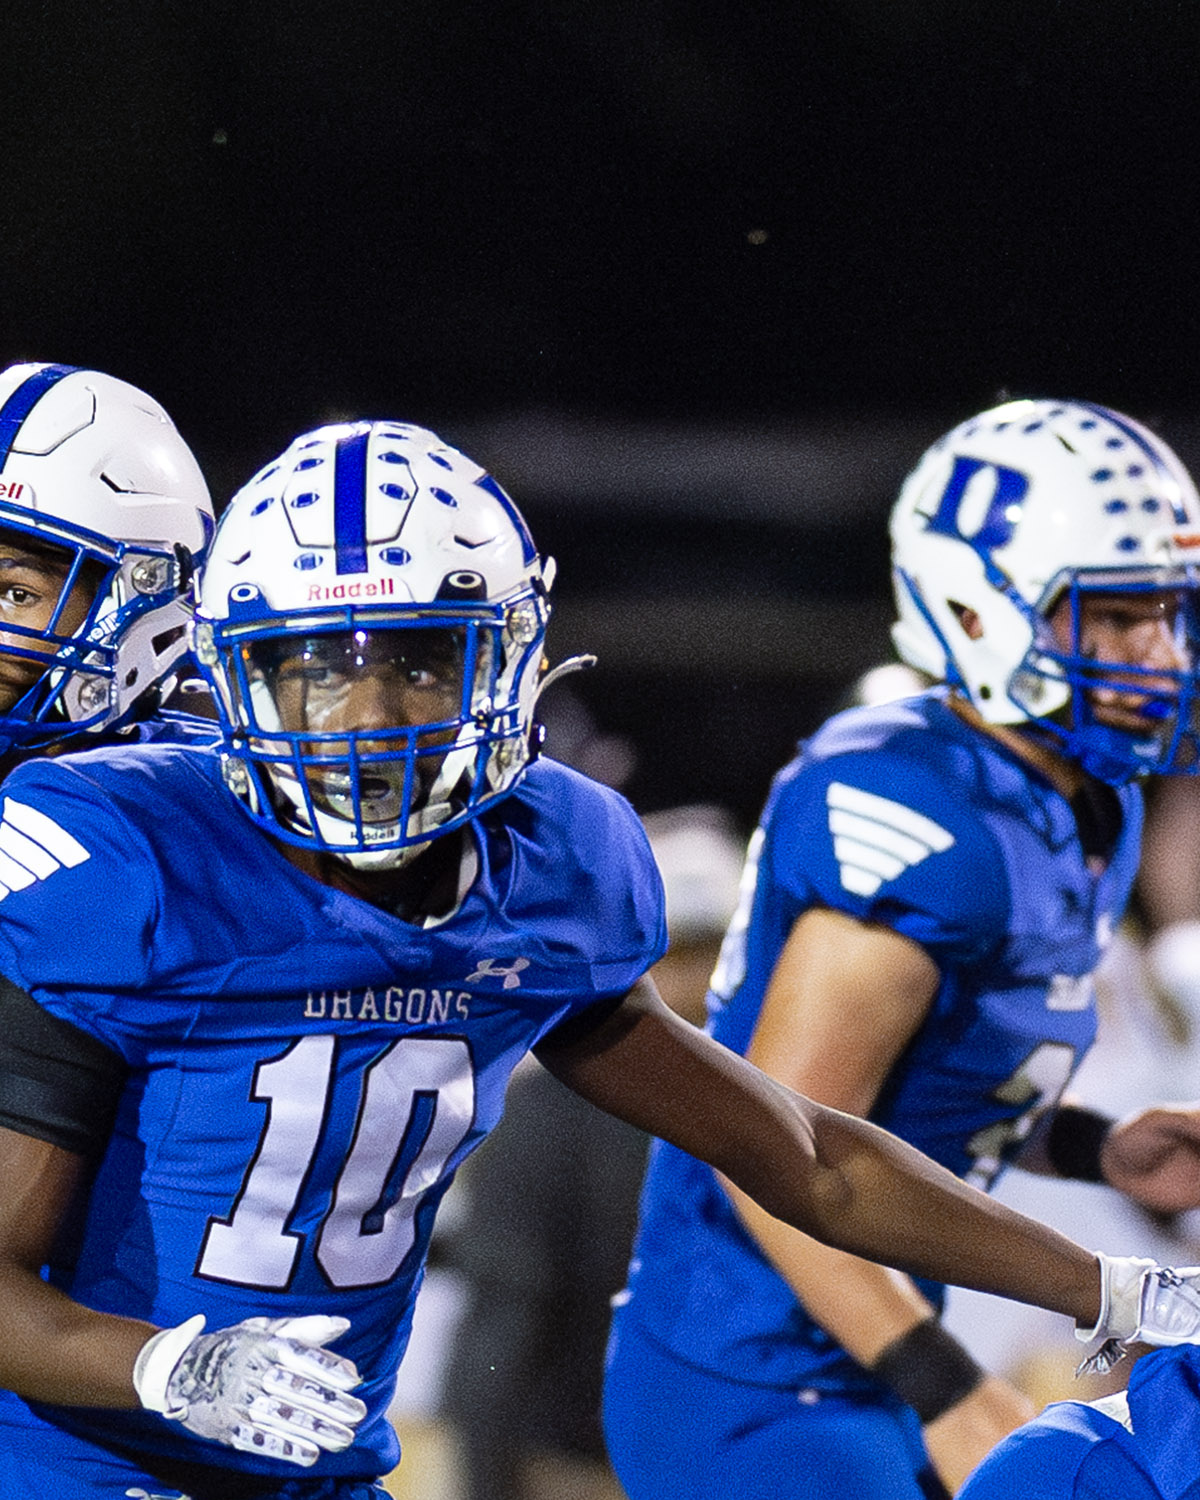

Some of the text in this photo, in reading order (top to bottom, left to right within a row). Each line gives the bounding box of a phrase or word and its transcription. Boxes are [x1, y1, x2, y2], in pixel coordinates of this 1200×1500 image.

[308, 578, 394, 600] Riddell
[351, 829, 395, 841] ddell
[304, 986, 472, 1025] DRAGONS
[195, 1033, 475, 1293] 10
